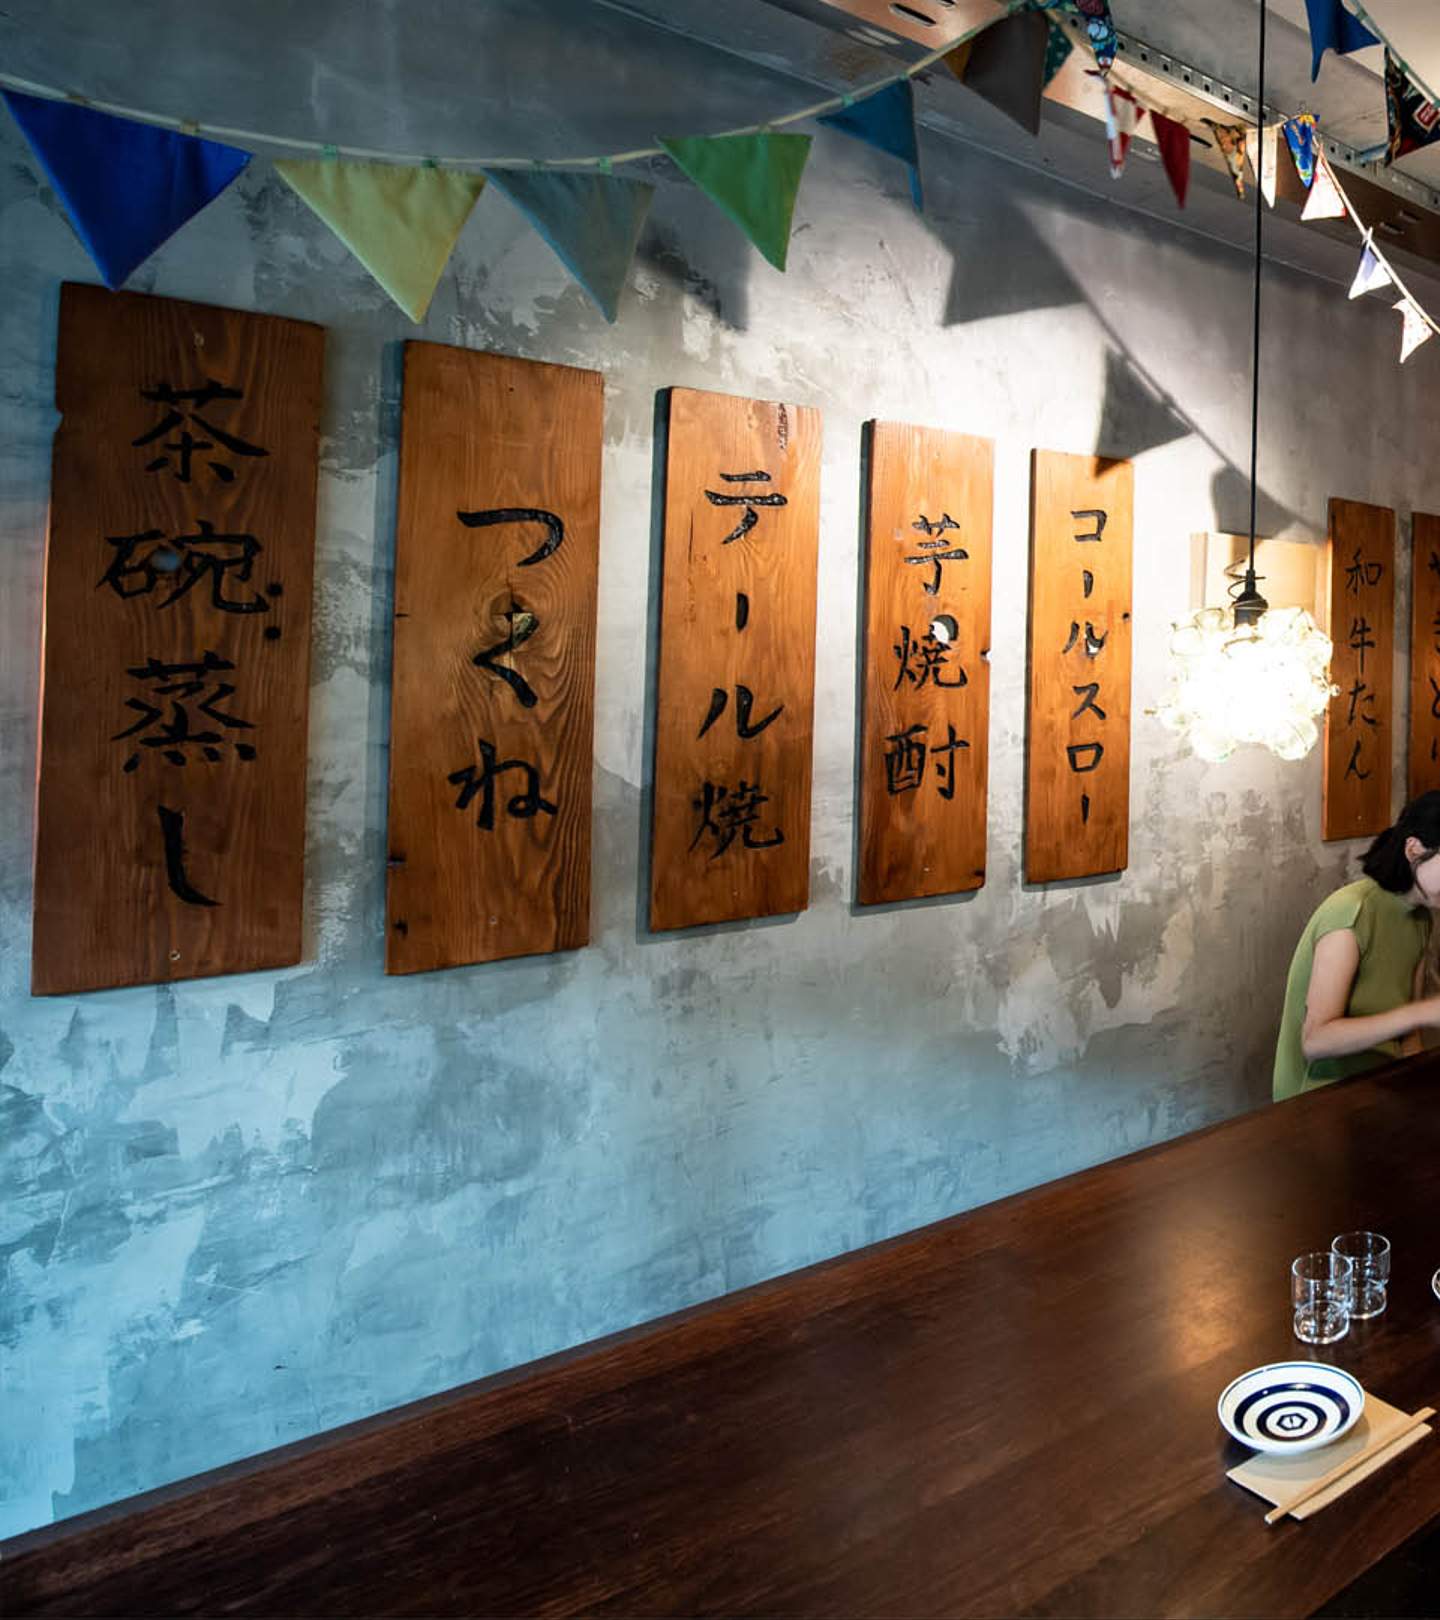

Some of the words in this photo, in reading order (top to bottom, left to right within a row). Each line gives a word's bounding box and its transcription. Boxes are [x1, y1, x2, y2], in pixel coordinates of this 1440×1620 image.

[96, 378, 270, 907] 茶碗蒸し
[448, 507, 564, 831] つくね
[689, 470, 788, 860] テール焼
[884, 513, 971, 799] 芋焼酎
[1063, 509, 1107, 824] コールスロー
[1344, 549, 1382, 781] 和牛たん
